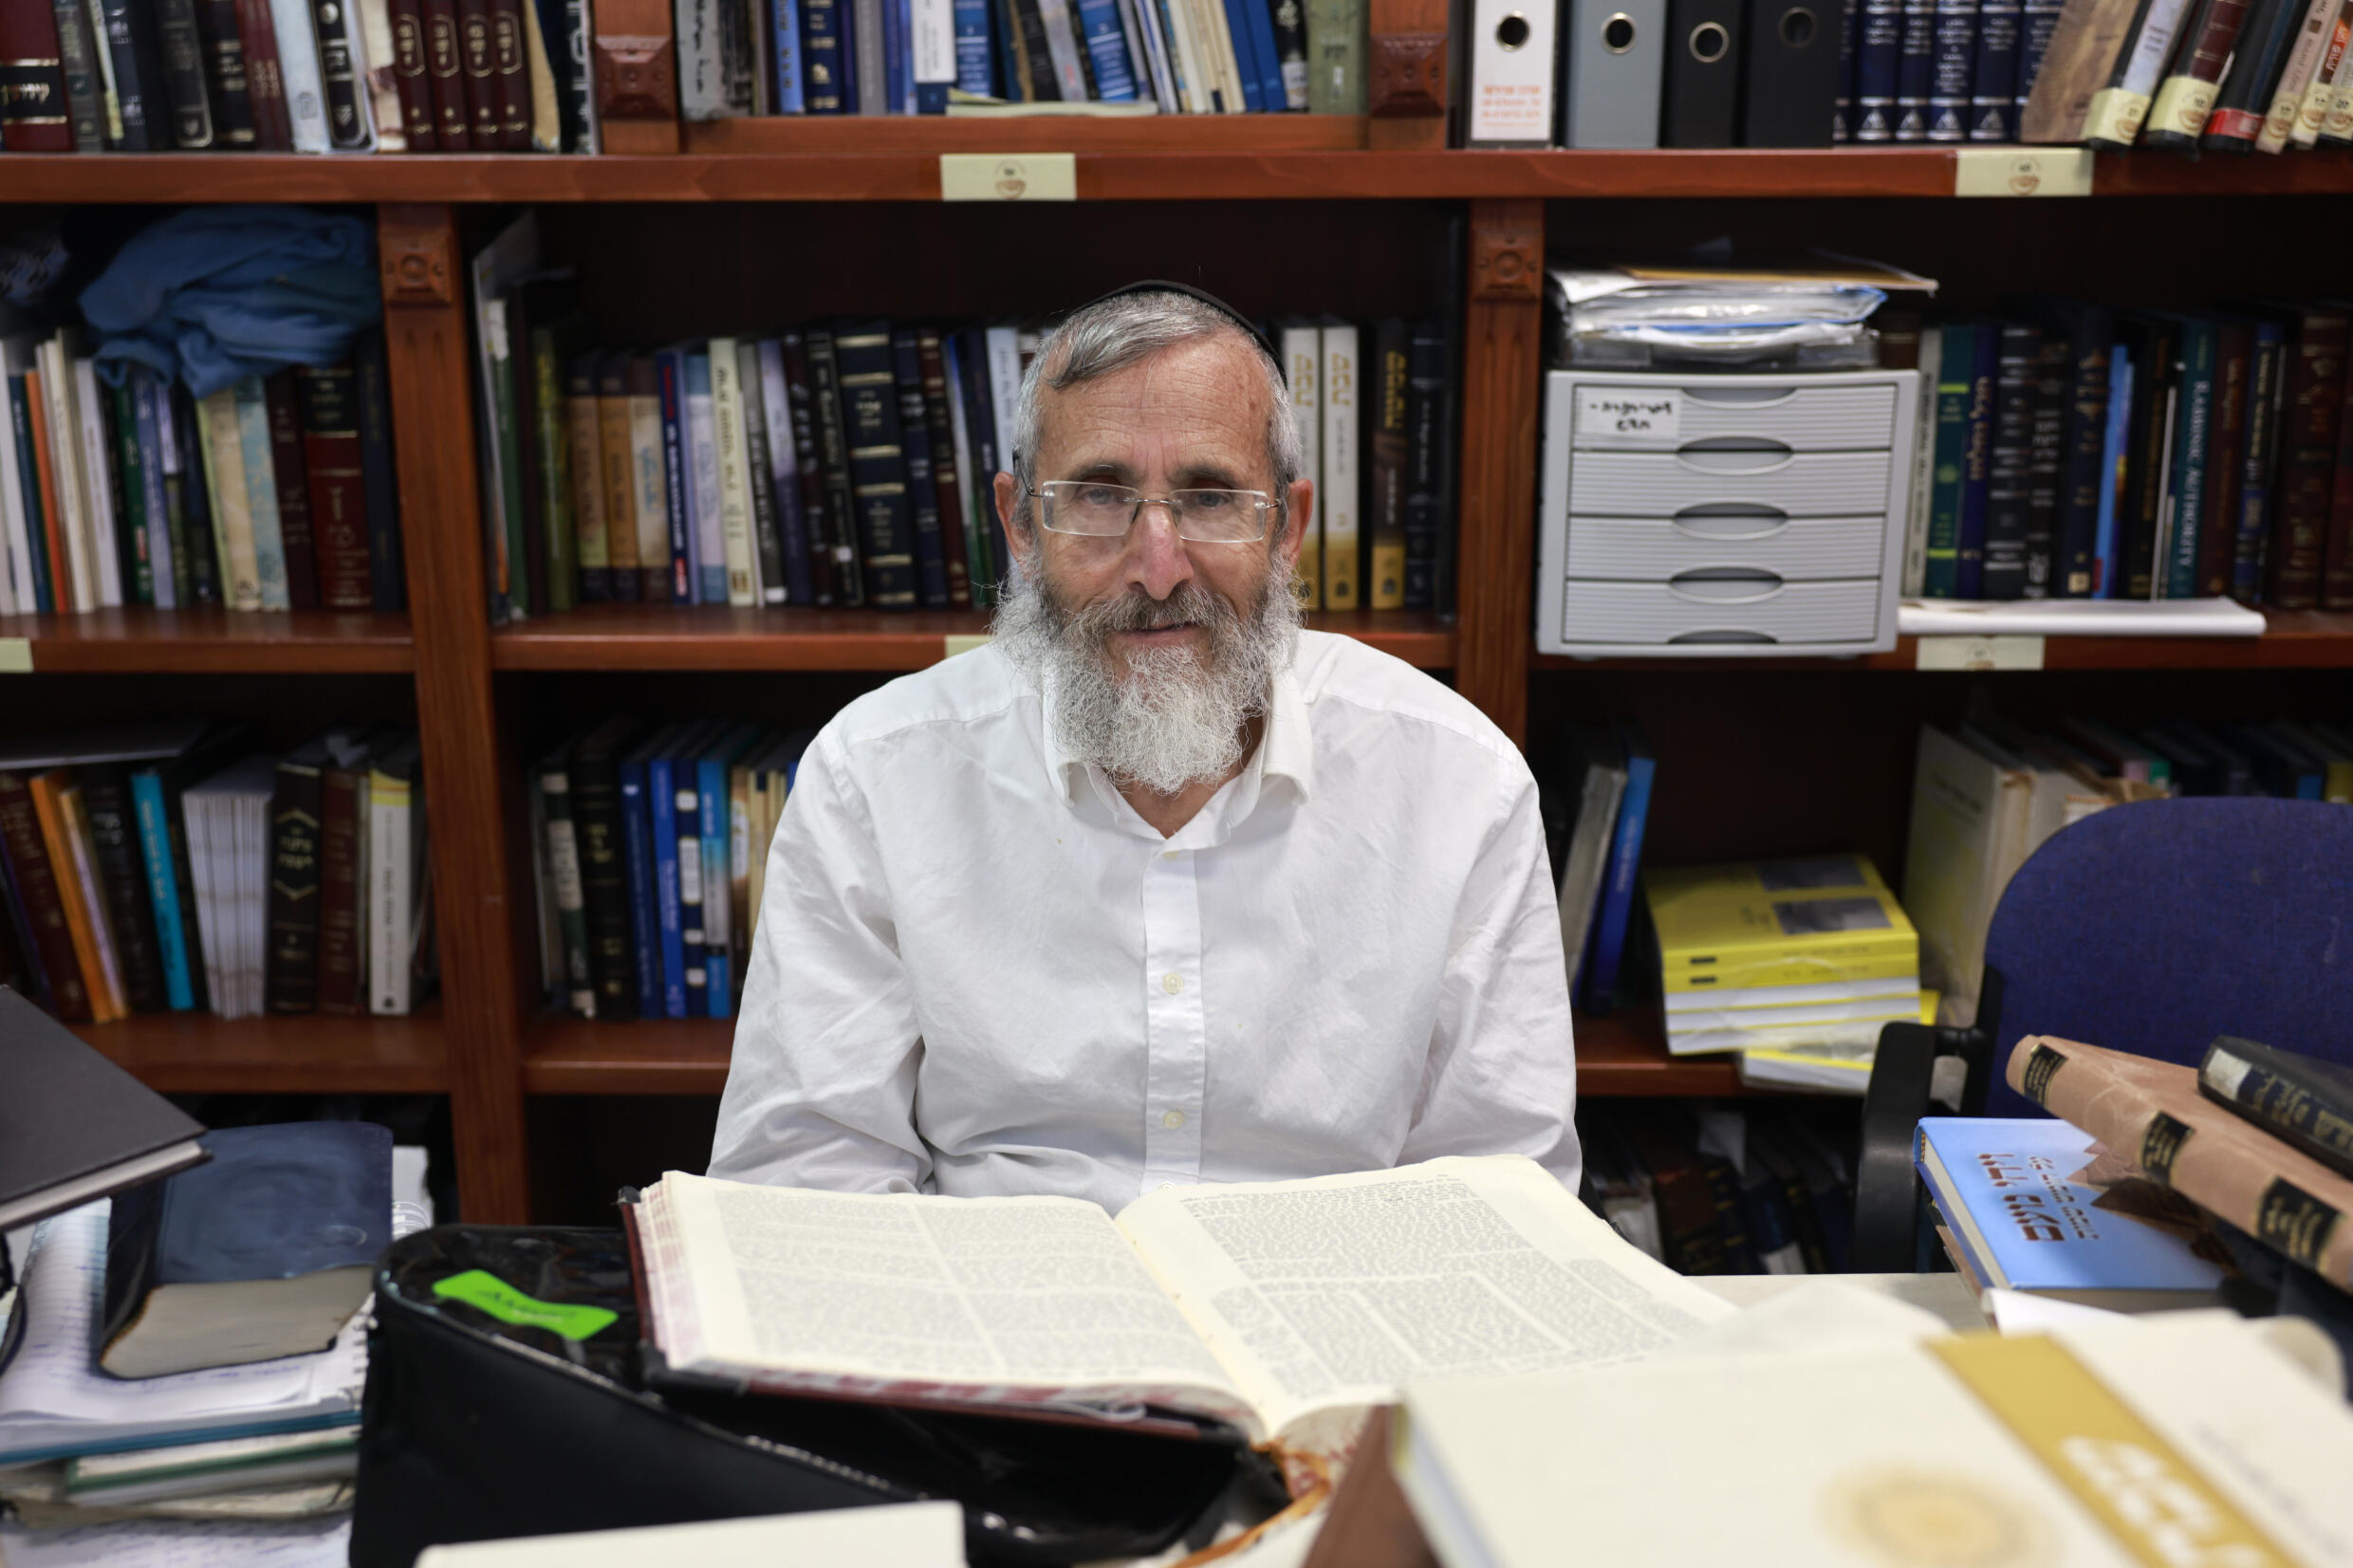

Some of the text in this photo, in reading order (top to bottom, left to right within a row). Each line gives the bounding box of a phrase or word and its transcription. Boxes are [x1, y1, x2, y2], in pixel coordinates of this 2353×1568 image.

[1293, 353, 1314, 408] שבת
[1331, 352, 1351, 407] שבת
[2178, 380, 2211, 567] RABBINIC AUTHORITY
[1978, 1153, 2065, 1241] ויהי נועם
